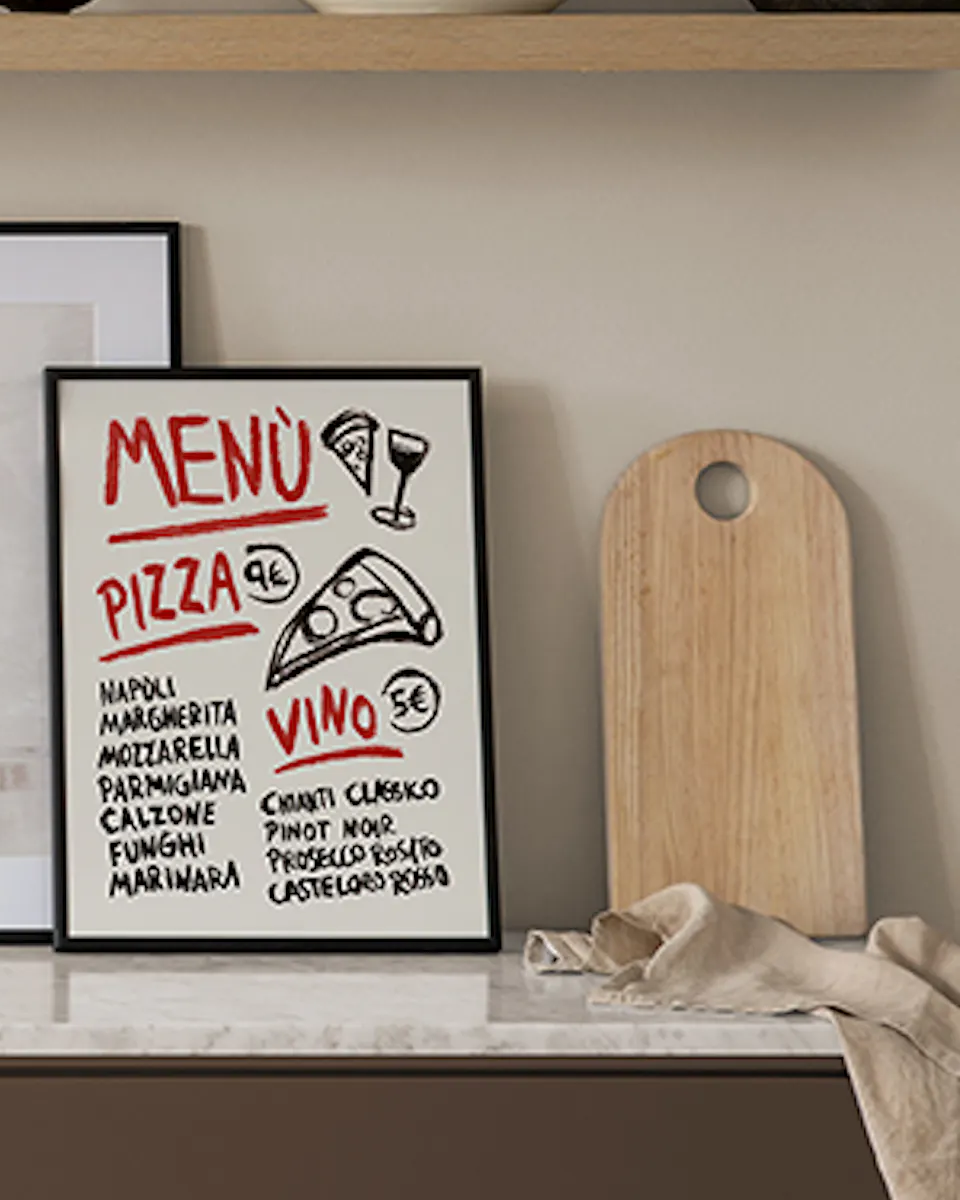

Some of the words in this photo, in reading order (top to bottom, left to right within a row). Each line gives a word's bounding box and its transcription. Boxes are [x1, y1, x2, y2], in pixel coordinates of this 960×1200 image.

[104, 406, 311, 508] MENÙ
[96, 552, 241, 640] PIZZA
[99, 676, 176, 706] NAPOLI
[99, 699, 237, 736] MARGHERITA
[266, 685, 378, 755] VINO
[391, 685, 429, 718] 5€
[97, 734, 240, 769] MOZZARELLA
[96, 768, 247, 803] PARMIGIANA
[259, 787, 336, 816] CHIANTI
[344, 777, 440, 807] CLASSICO
[99, 801, 215, 834] CALZONE
[264, 820, 331, 842] PINOT
[343, 813, 397, 839] NOIR
[109, 830, 206, 867] FUNGHI
[109, 860, 240, 898] MARINARA
[388, 864, 450, 897] ROSSO
